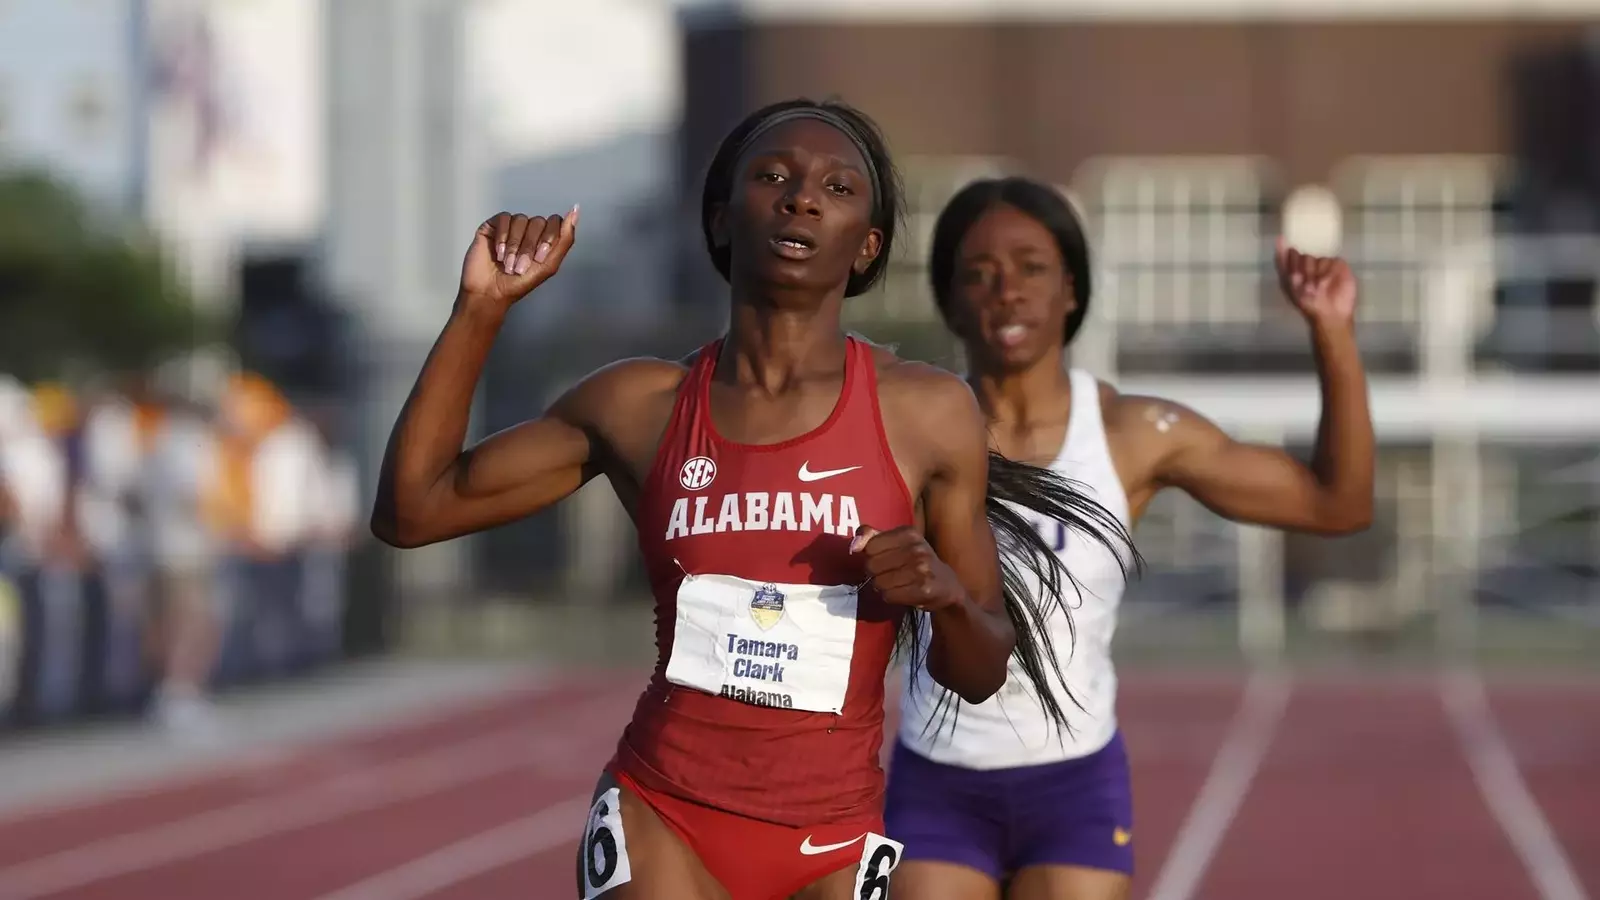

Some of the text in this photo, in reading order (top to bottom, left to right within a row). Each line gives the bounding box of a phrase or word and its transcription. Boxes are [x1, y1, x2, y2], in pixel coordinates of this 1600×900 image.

[682, 458, 715, 488] SEC
[665, 491, 861, 540] ALABAMA
[727, 633, 799, 660] Tamara
[733, 658, 784, 682] Clark
[720, 684, 793, 708] Alabama
[587, 799, 618, 888] 6
[860, 844, 896, 900] 6
